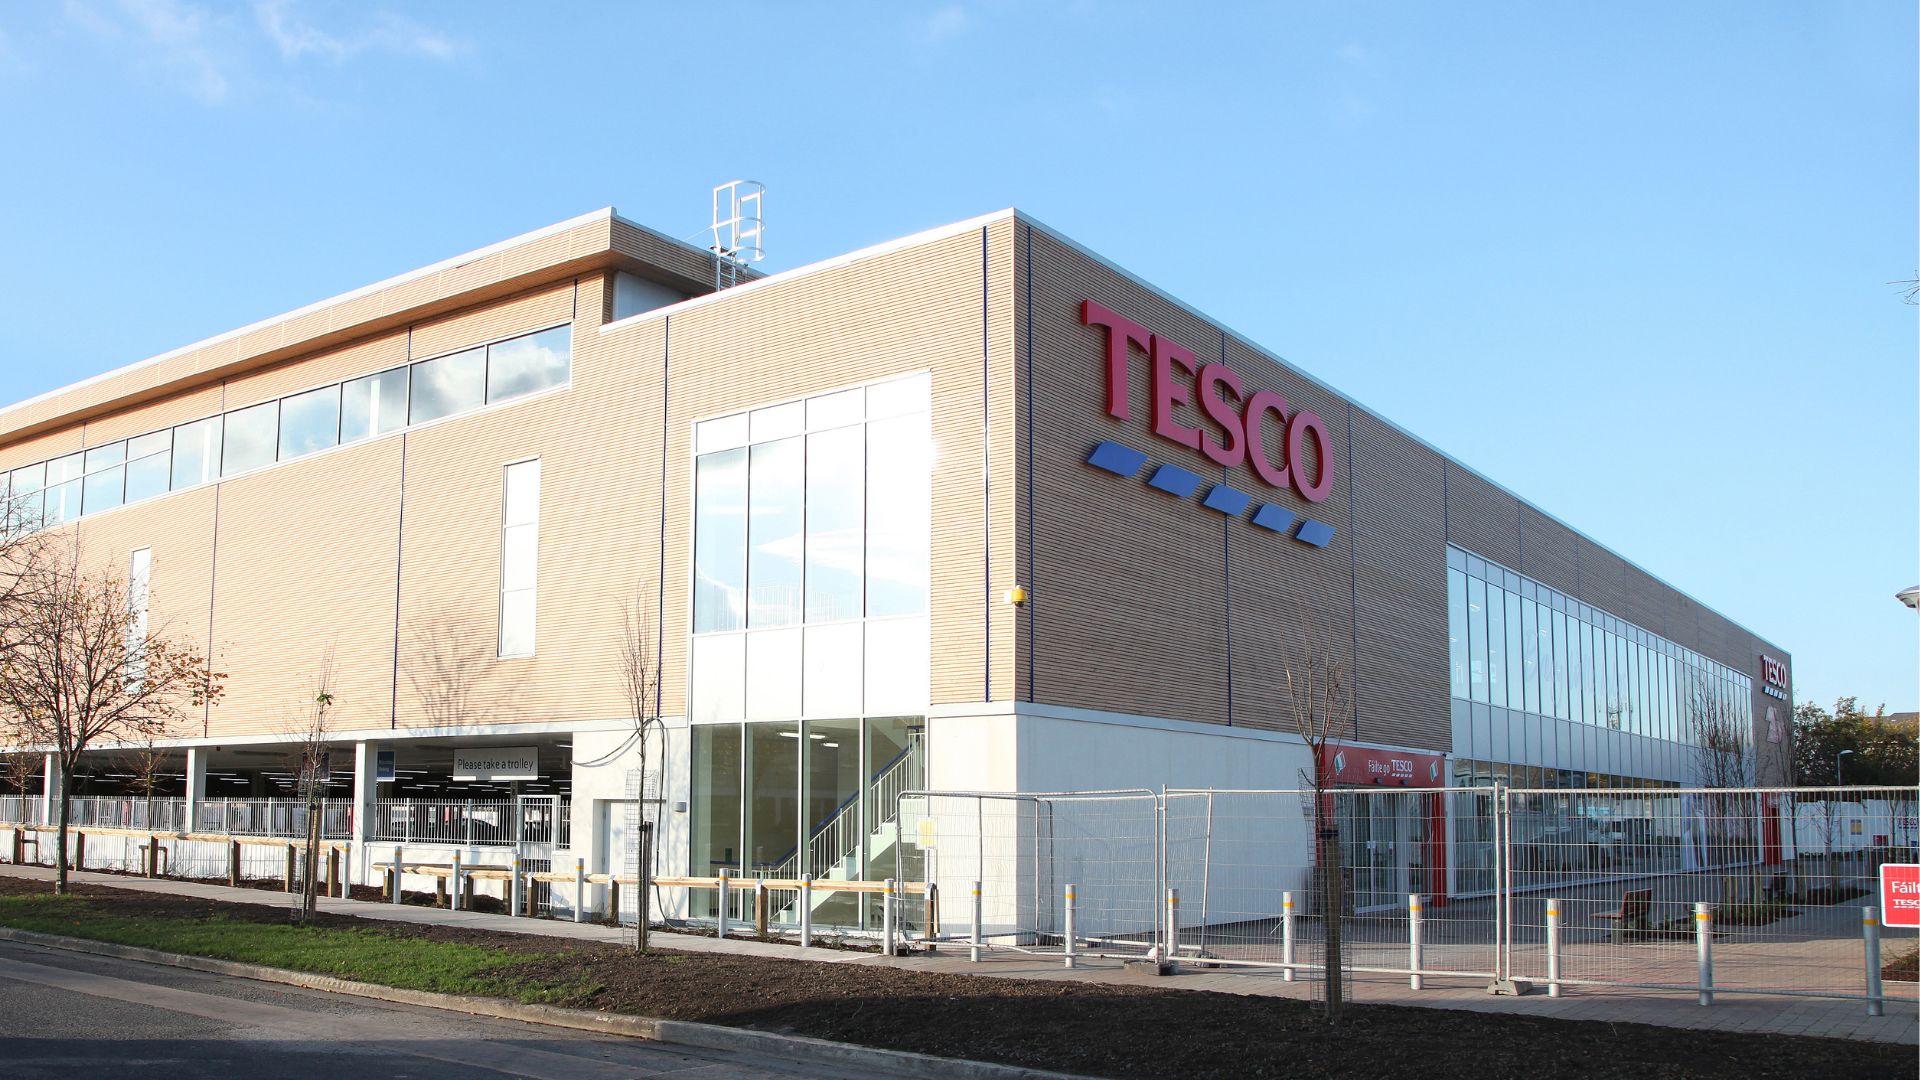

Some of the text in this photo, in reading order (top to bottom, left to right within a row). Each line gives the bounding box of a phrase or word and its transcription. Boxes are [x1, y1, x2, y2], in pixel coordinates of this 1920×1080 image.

[1081, 299, 1334, 502] TESCO
[1761, 655, 1786, 689] TESCO
[457, 758, 482, 770] Please
[483, 758, 501, 770] take
[507, 757, 534, 771] trolley
[1391, 759, 1412, 772] TESCO
